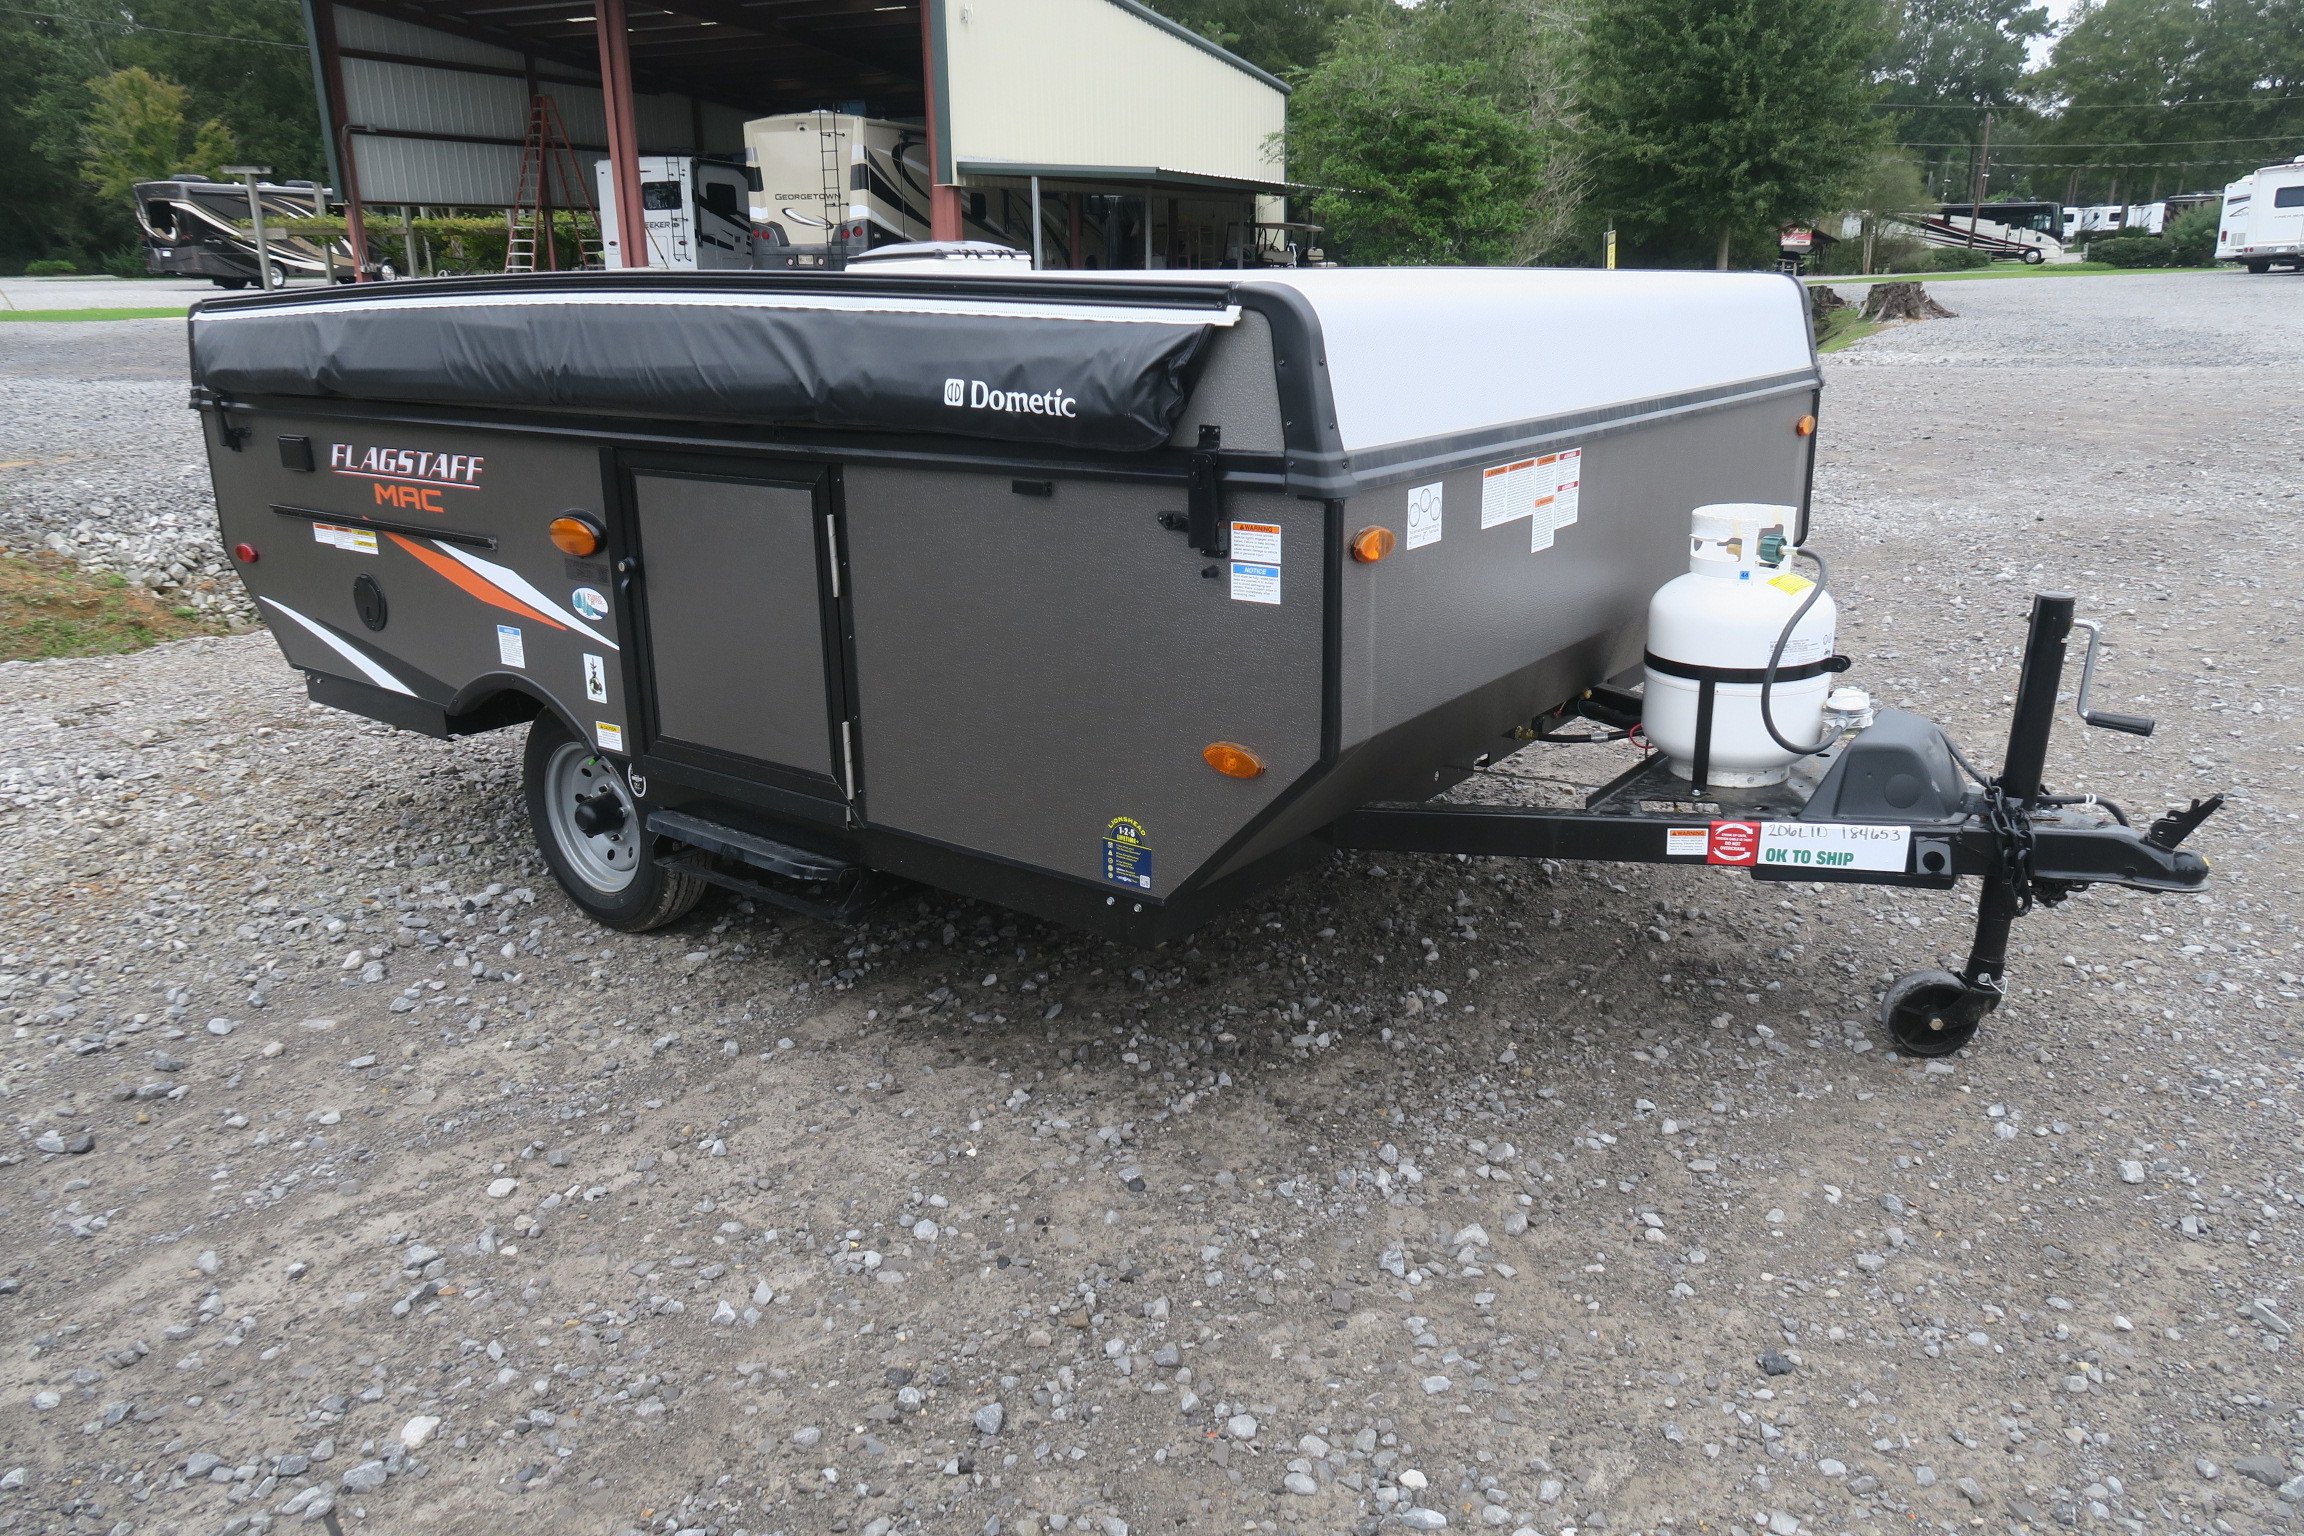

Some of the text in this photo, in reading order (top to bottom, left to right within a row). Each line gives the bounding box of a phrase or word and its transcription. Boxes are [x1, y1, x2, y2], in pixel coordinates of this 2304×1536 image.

[644, 221, 671, 229] EEKER
[970, 380, 1076, 418] Dometic
[331, 443, 485, 482] FLAGSTAFF
[373, 483, 444, 513] MAC
[1245, 524, 1272, 532] WARNING
[1244, 566, 1266, 575] NOTICE
[1842, 827, 1901, 841] 184653
[1765, 848, 1854, 866] OK TO SHIP
